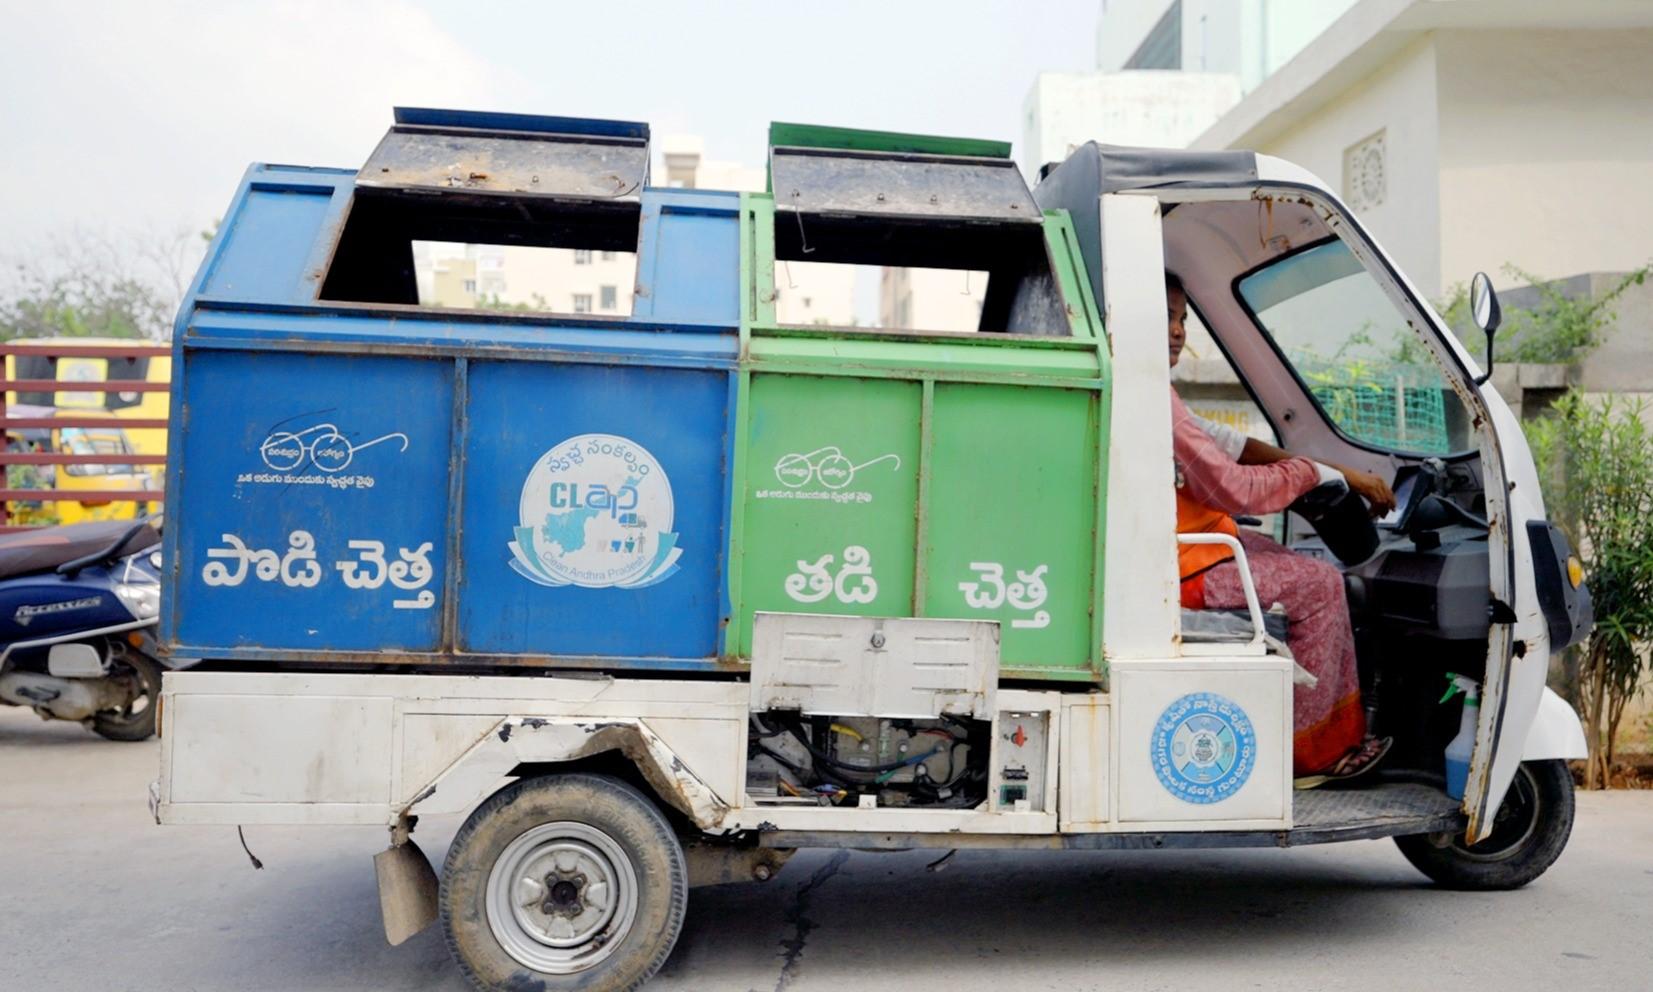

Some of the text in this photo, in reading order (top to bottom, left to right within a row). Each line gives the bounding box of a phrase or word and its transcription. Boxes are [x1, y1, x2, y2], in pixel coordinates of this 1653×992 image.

[586, 439, 650, 476] సంకల్పం
[202, 530, 436, 609] పొడి చెత్త
[542, 551, 647, 580] Clean Andhra Pradesh
[784, 545, 1051, 628] తడి చెత్త
